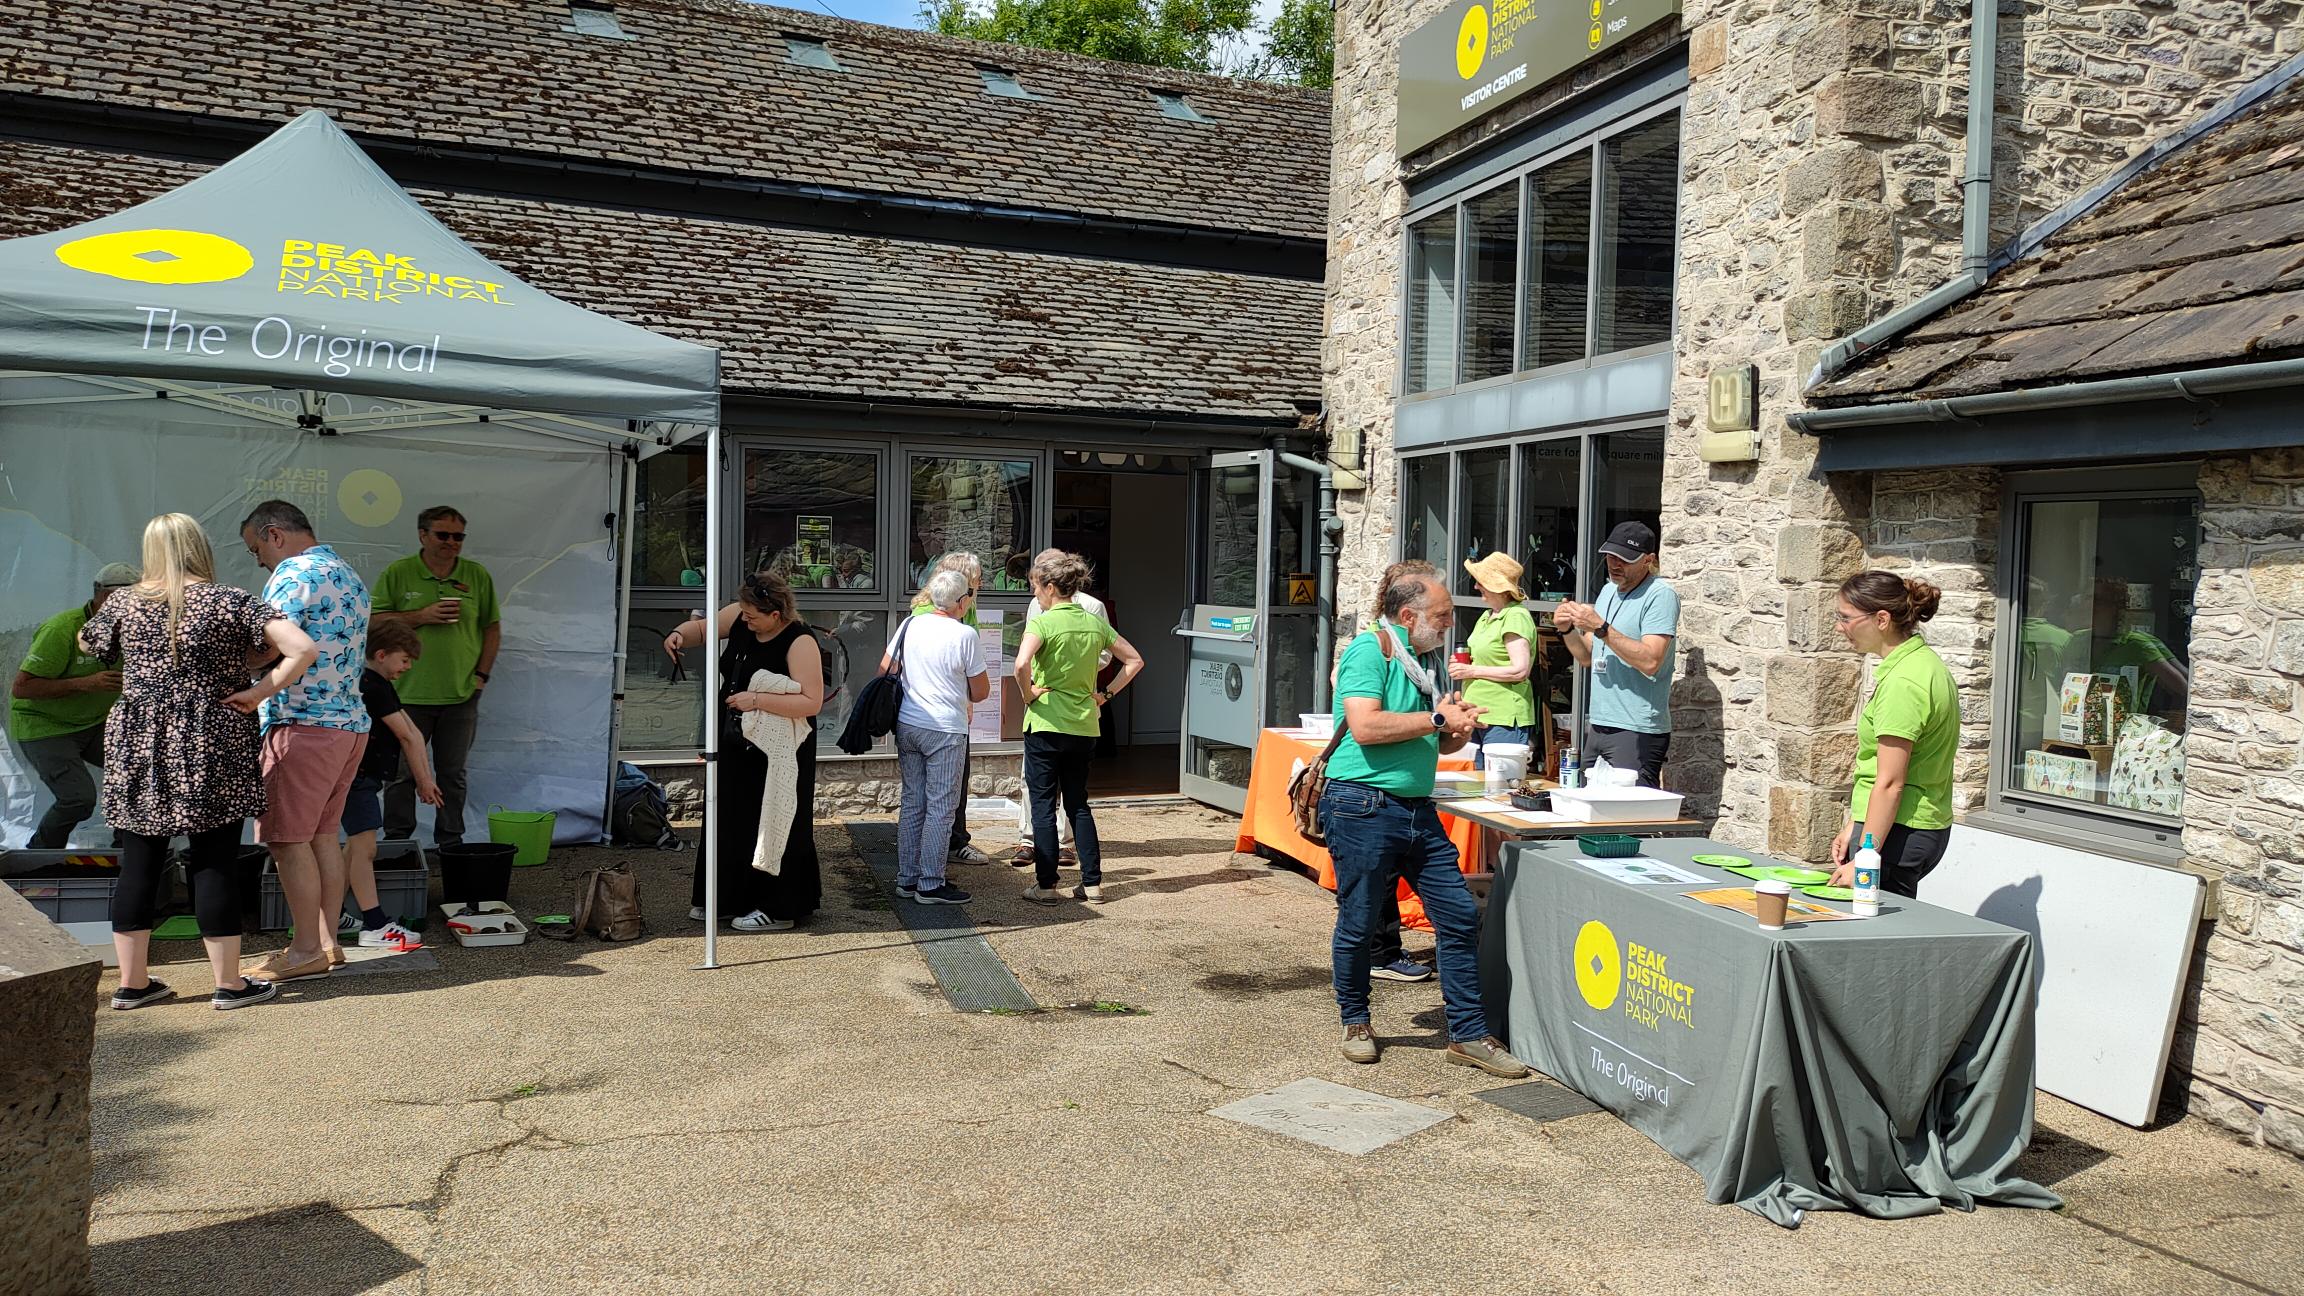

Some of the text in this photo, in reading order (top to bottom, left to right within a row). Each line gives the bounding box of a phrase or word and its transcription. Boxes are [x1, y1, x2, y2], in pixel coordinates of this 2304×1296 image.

[1491, 5, 1538, 43] NATIONAL
[1607, 16, 1628, 35] Maps
[1490, 34, 1515, 59] PARK
[1461, 63, 1528, 111] VISITOR CENTRE
[283, 239, 417, 270] PEAK
[279, 267, 516, 306] NATIONAL
[281, 253, 505, 293] DISTRICT
[277, 280, 403, 304] PARK
[135, 305, 441, 378] The Original
[1628, 941, 1668, 975] PEAK
[1627, 961, 1695, 1006] DISTRICT
[1625, 1000, 1659, 1032] PARK
[1626, 981, 1695, 1029] NATIONAL
[1591, 1046, 1613, 1078] The
